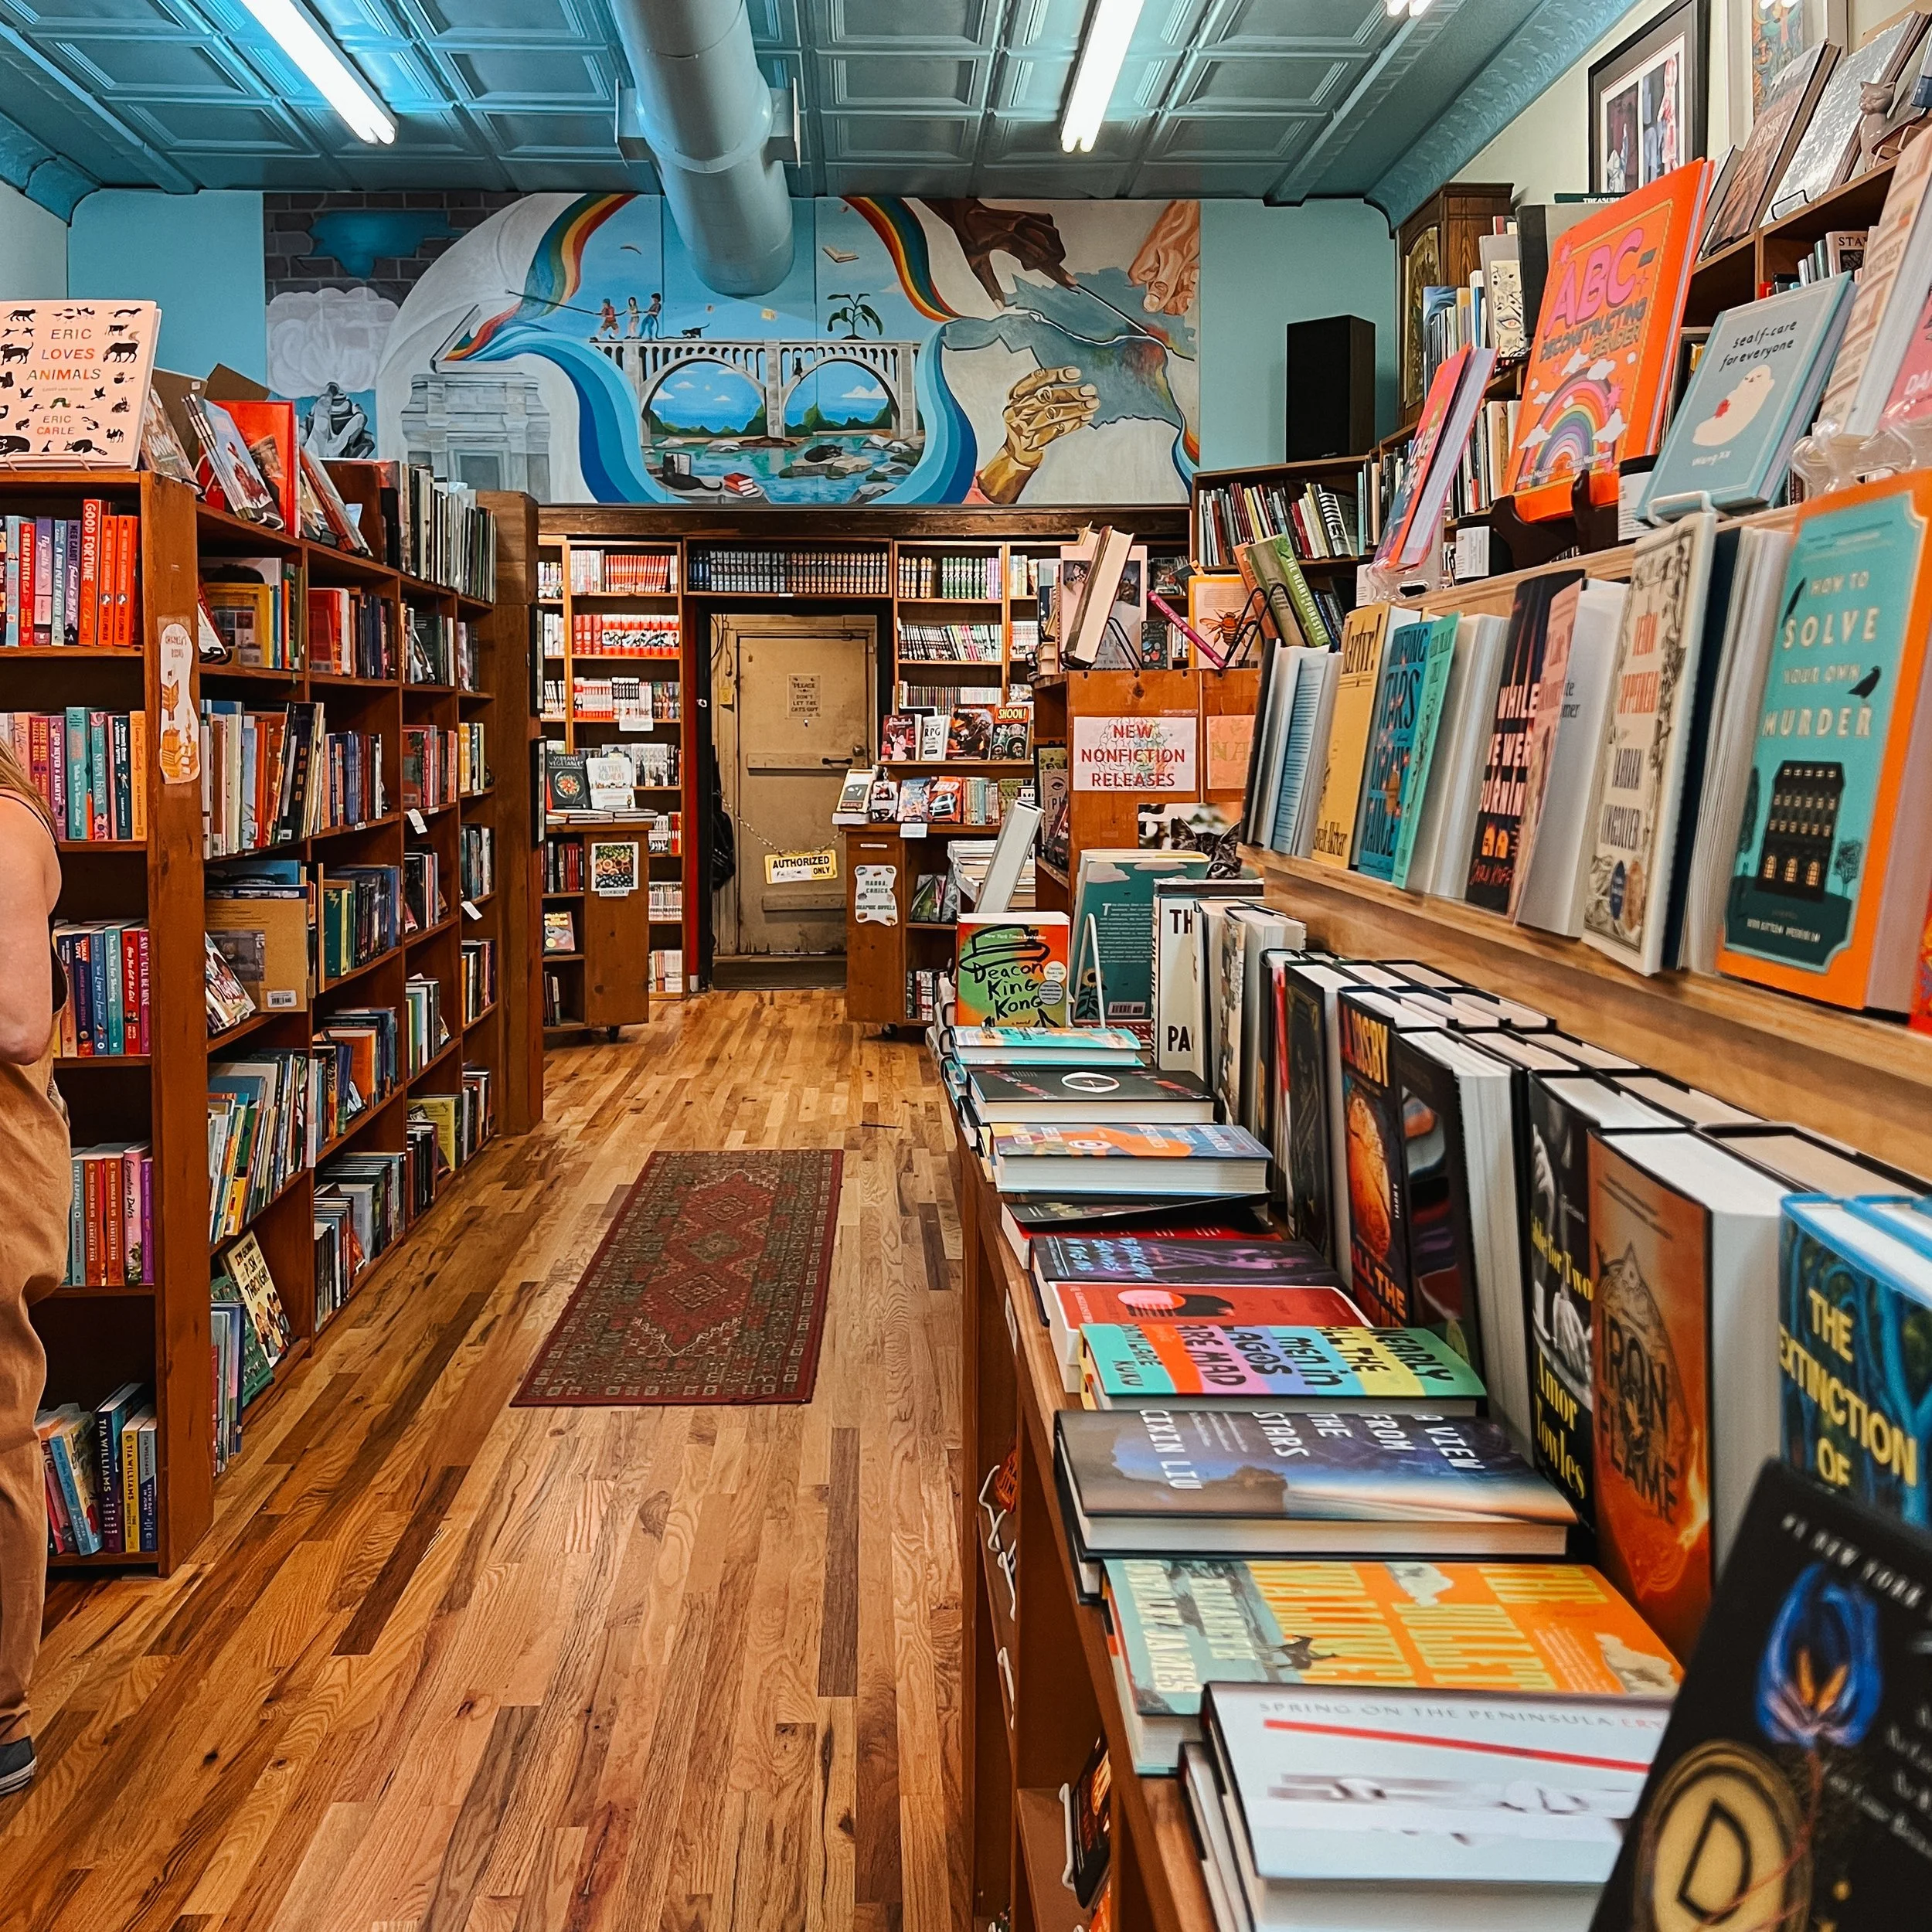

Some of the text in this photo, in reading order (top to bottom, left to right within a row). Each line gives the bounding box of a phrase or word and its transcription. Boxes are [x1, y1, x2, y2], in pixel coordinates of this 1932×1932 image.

[51, 328, 92, 340] ERIC
[1590, 324, 1641, 362] GENDER
[1732, 320, 1798, 350] sealf-care
[42, 348, 95, 361] LOVES
[1739, 338, 1795, 363] everyone
[26, 369, 101, 382] ANIMALS
[36, 427, 75, 436] CARLE
[43, 414, 72, 424] ERIC
[83, 503, 96, 581] GOOD FORTUNE
[1286, 556, 1309, 598] THE HEART
[1810, 571, 1870, 596] HOW TO
[1304, 601, 1323, 630] FOREST
[1782, 607, 1879, 649] SOLVE
[1783, 664, 1861, 686] YOUR OWN
[998, 708, 1026, 720] SHOOK!
[1498, 682, 1539, 719] WHILE
[1113, 723, 1154, 740] NEW
[1762, 706, 1872, 738] MURDER
[1081, 748, 1185, 764] NONFICTION
[1090, 773, 1175, 787] RELEASES
[773, 855, 830, 869] AUTHORIZED
[813, 866, 830, 875] ONLY
[1168, 909, 1192, 934] TH
[141, 978, 149, 988] BE
[972, 962, 1044, 984] Deacon
[1167, 1026, 1192, 1052] PA
[127, 1197, 135, 1219] Dates
[1562, 1250, 1594, 1302] Two
[1375, 1265, 1406, 1319] THE
[1808, 1287, 1854, 1363] THE
[1175, 1325, 1247, 1387] ARE MAD
[1314, 1325, 1392, 1372] ALL THE
[1365, 1327, 1456, 1382] NEARLY
[1111, 1359, 1145, 1387] KUKU
[1250, 1410, 1310, 1459] STARS
[1306, 1413, 1354, 1439] THE
[1359, 1413, 1417, 1452] FROM
[1138, 1408, 1204, 1491] CIXIN LIU
[1423, 1427, 1486, 1470] VIEW
[1817, 1437, 1852, 1487] OF
[101, 1438, 111, 1492] WILLIAMS
[1478, 1566, 1608, 1604] THE
[1189, 1577, 1257, 1662] ELIZABETH
[1141, 1628, 1203, 1693] JAMES
[1390, 1602, 1556, 1692] BULLET
[1260, 1702, 1613, 1726] SPRING ON THE PENINSULA
